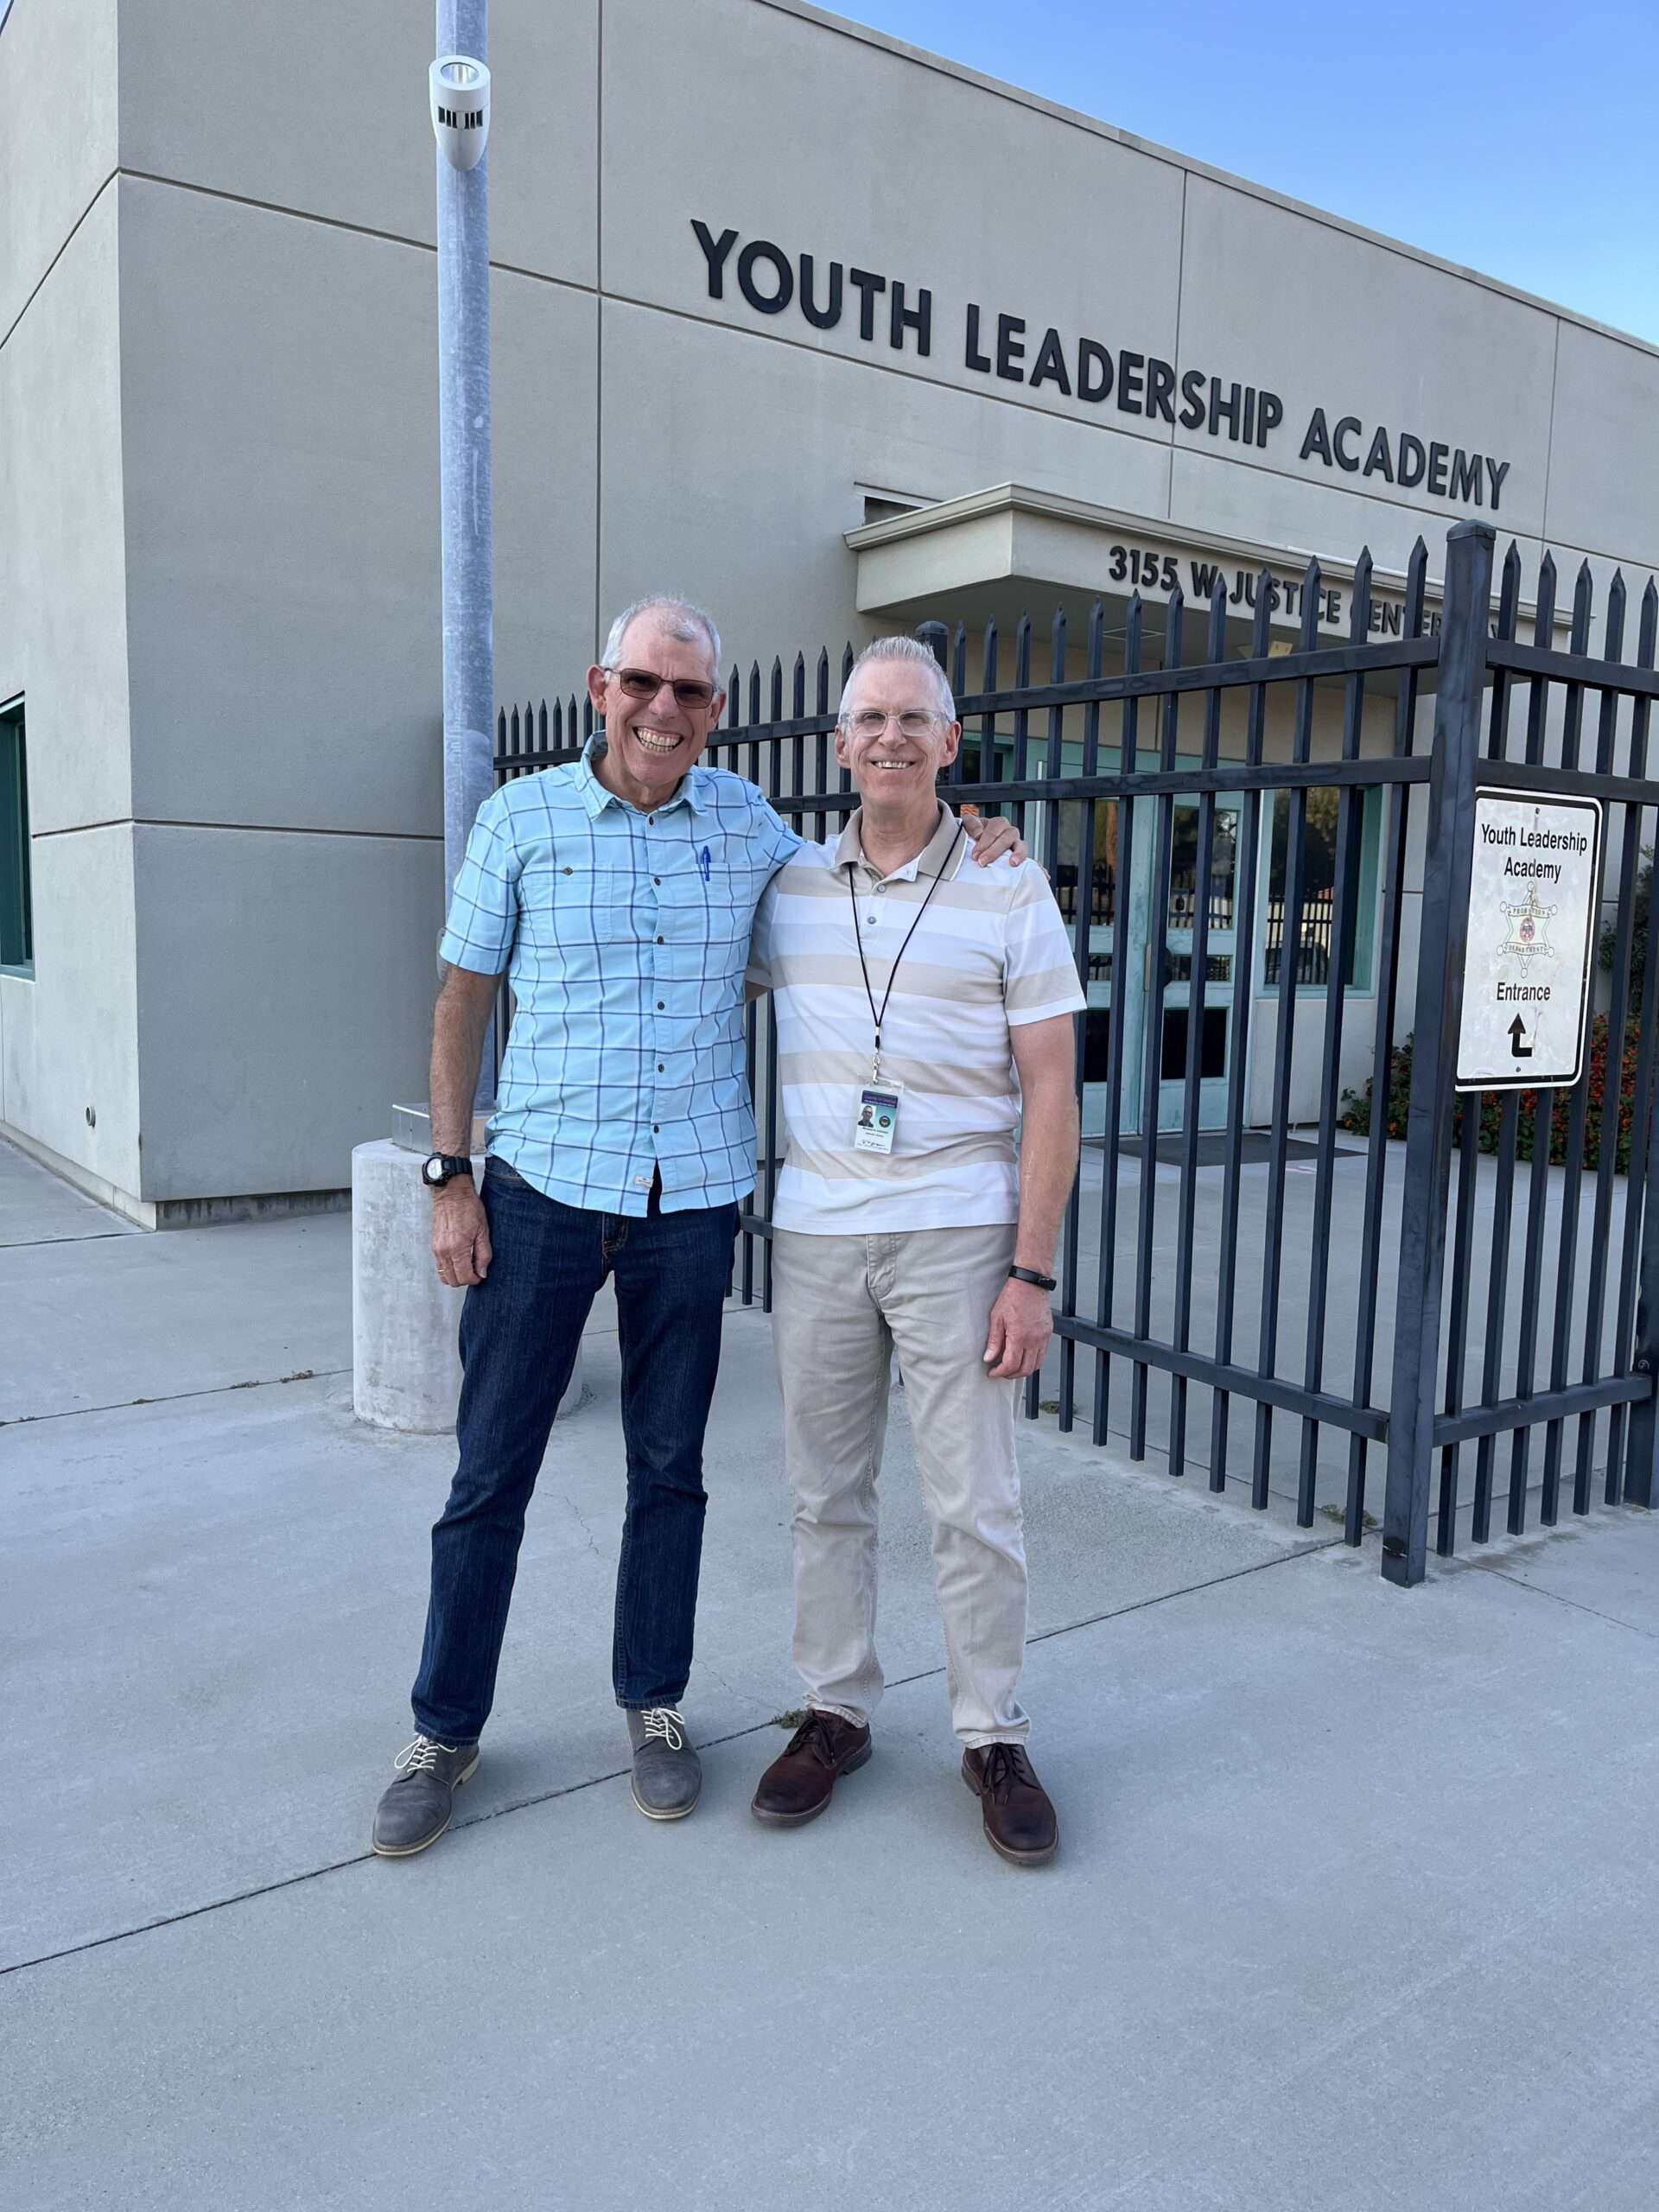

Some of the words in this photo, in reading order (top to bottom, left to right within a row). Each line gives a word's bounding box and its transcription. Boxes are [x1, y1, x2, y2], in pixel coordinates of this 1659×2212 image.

[691, 219, 931, 357] YOUTH
[965, 303, 1284, 448] LEADERSHIP
[1300, 408, 1510, 510] ACADEMY
[1109, 545, 1179, 592] 3155
[1191, 561, 1219, 599] W
[1481, 823, 1516, 846] Youth
[1520, 826, 1587, 856] Leadership
[1503, 856, 1561, 884] Academy
[1497, 982, 1551, 1001] Entrance
